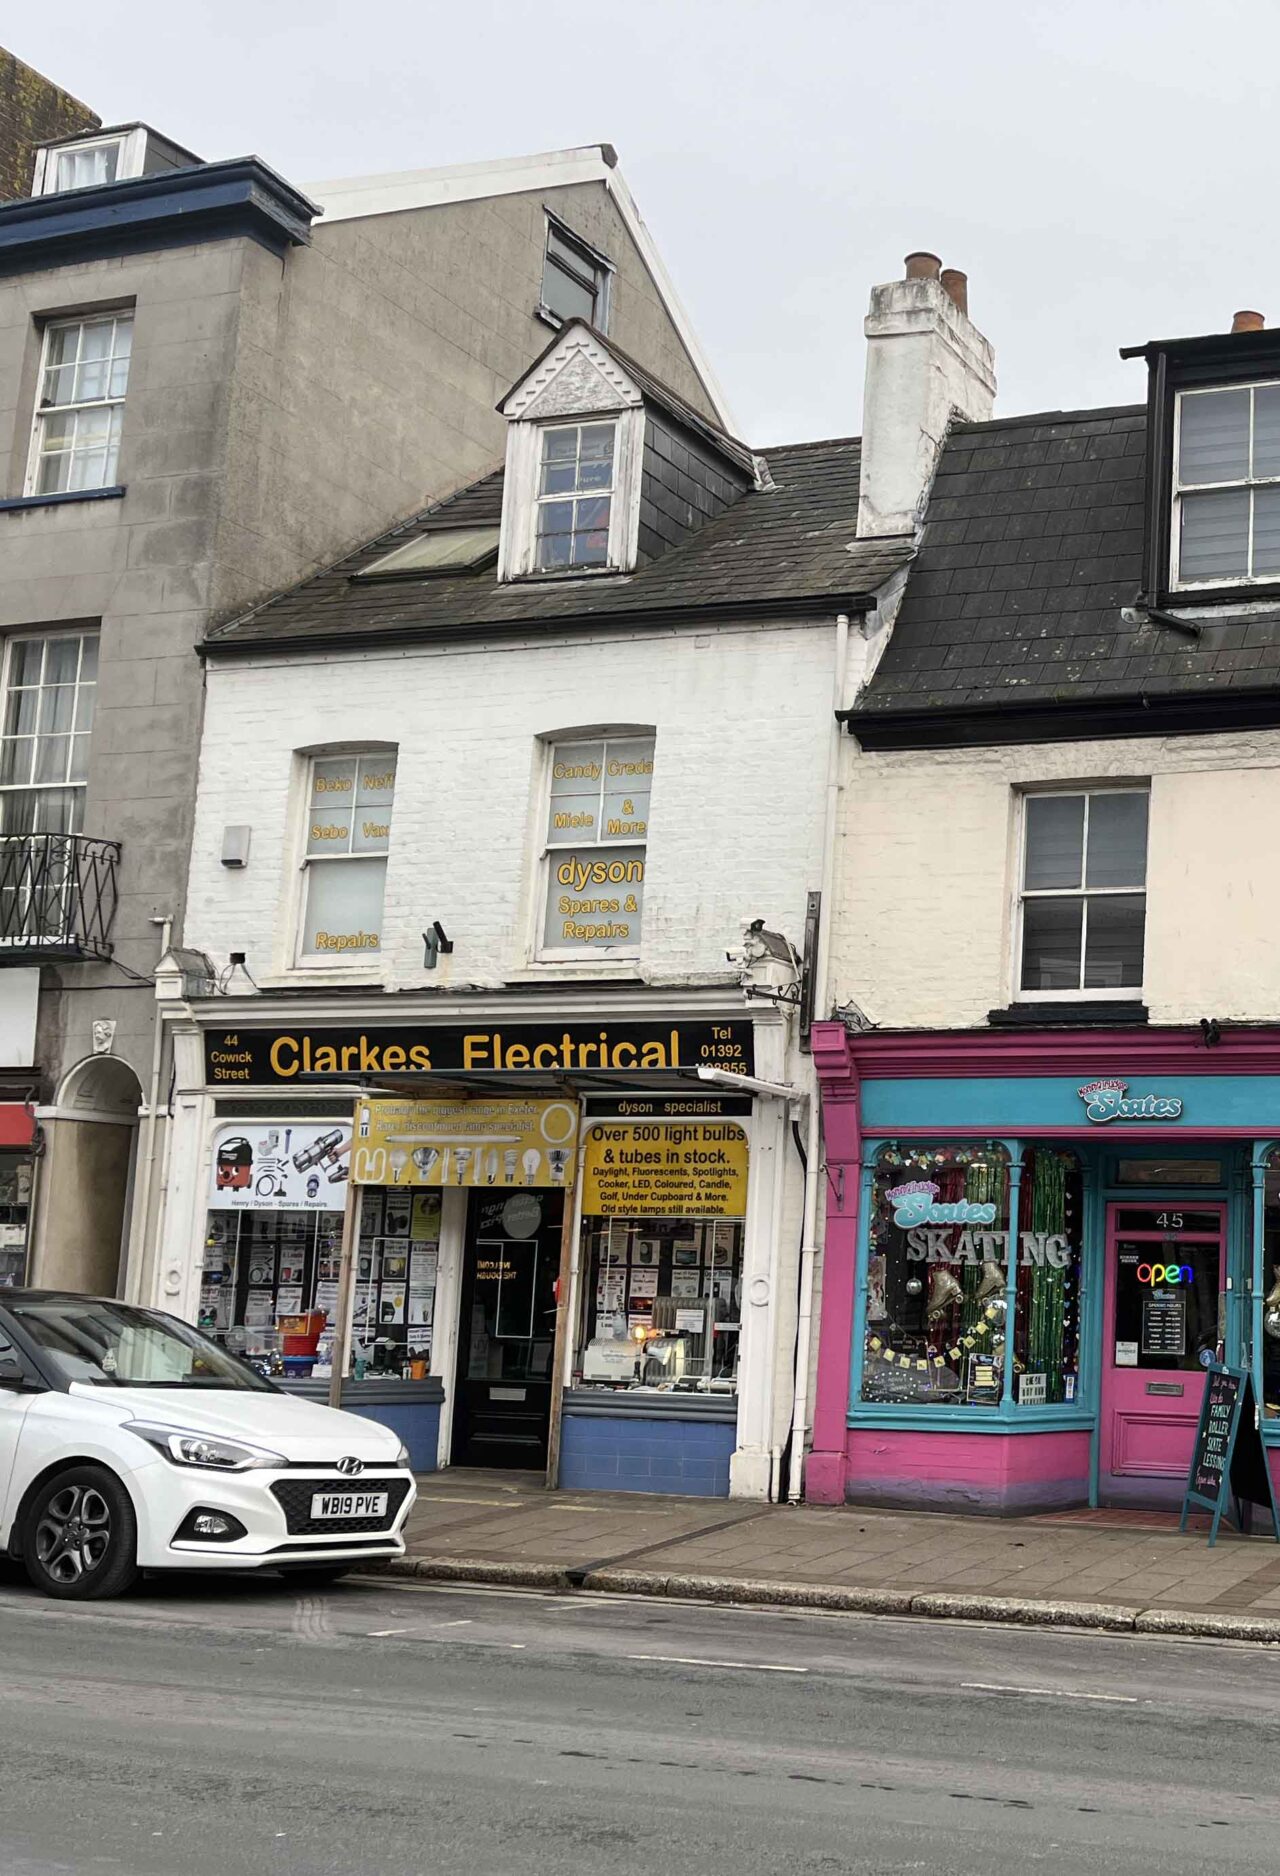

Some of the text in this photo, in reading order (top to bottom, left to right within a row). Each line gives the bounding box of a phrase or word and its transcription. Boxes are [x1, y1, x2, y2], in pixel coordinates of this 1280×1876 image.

[553, 758, 654, 781] Candy Creda
[315, 772, 395, 793] Beko Neff
[622, 799, 634, 816] &
[554, 811, 594, 829] Miele
[607, 819, 646, 836] More
[311, 824, 348, 841] Sebo
[557, 855, 645, 893] dyson
[558, 894, 638, 917] Spares &
[562, 920, 629, 943] Repairs
[315, 931, 379, 953] Repairs
[223, 1034, 239, 1047] 44
[711, 1026, 732, 1040] Tel
[210, 1051, 253, 1064] Cowick
[270, 1029, 680, 1078] Clarkes Electrical
[700, 1044, 743, 1058] 01392
[214, 1067, 250, 1080] Street
[618, 1100, 722, 1115] dyson specialist
[1083, 1088, 1182, 1122] Skates
[591, 1126, 746, 1145] Over 500 light bulbs
[603, 1149, 731, 1164] & tubes in stock.
[592, 1167, 739, 1178] Daylight, Fluorescents, Spotlights,
[598, 1179, 732, 1190] Cooker, LED, Coloured, Candle,
[600, 1192, 729, 1203] Golf, Under Cupboard & More.
[601, 1204, 727, 1215] Old style lamps still available.
[892, 1191, 997, 1229] Skates
[1156, 1212, 1184, 1228] 45
[1136, 1263, 1194, 1287] open
[1210, 1404, 1231, 1419] FAMILY
[1208, 1420, 1229, 1436] ROLLER
[1206, 1437, 1223, 1452] SKATE
[1202, 1454, 1226, 1471] LESSONS
[321, 1495, 380, 1515] WB19 PVE
